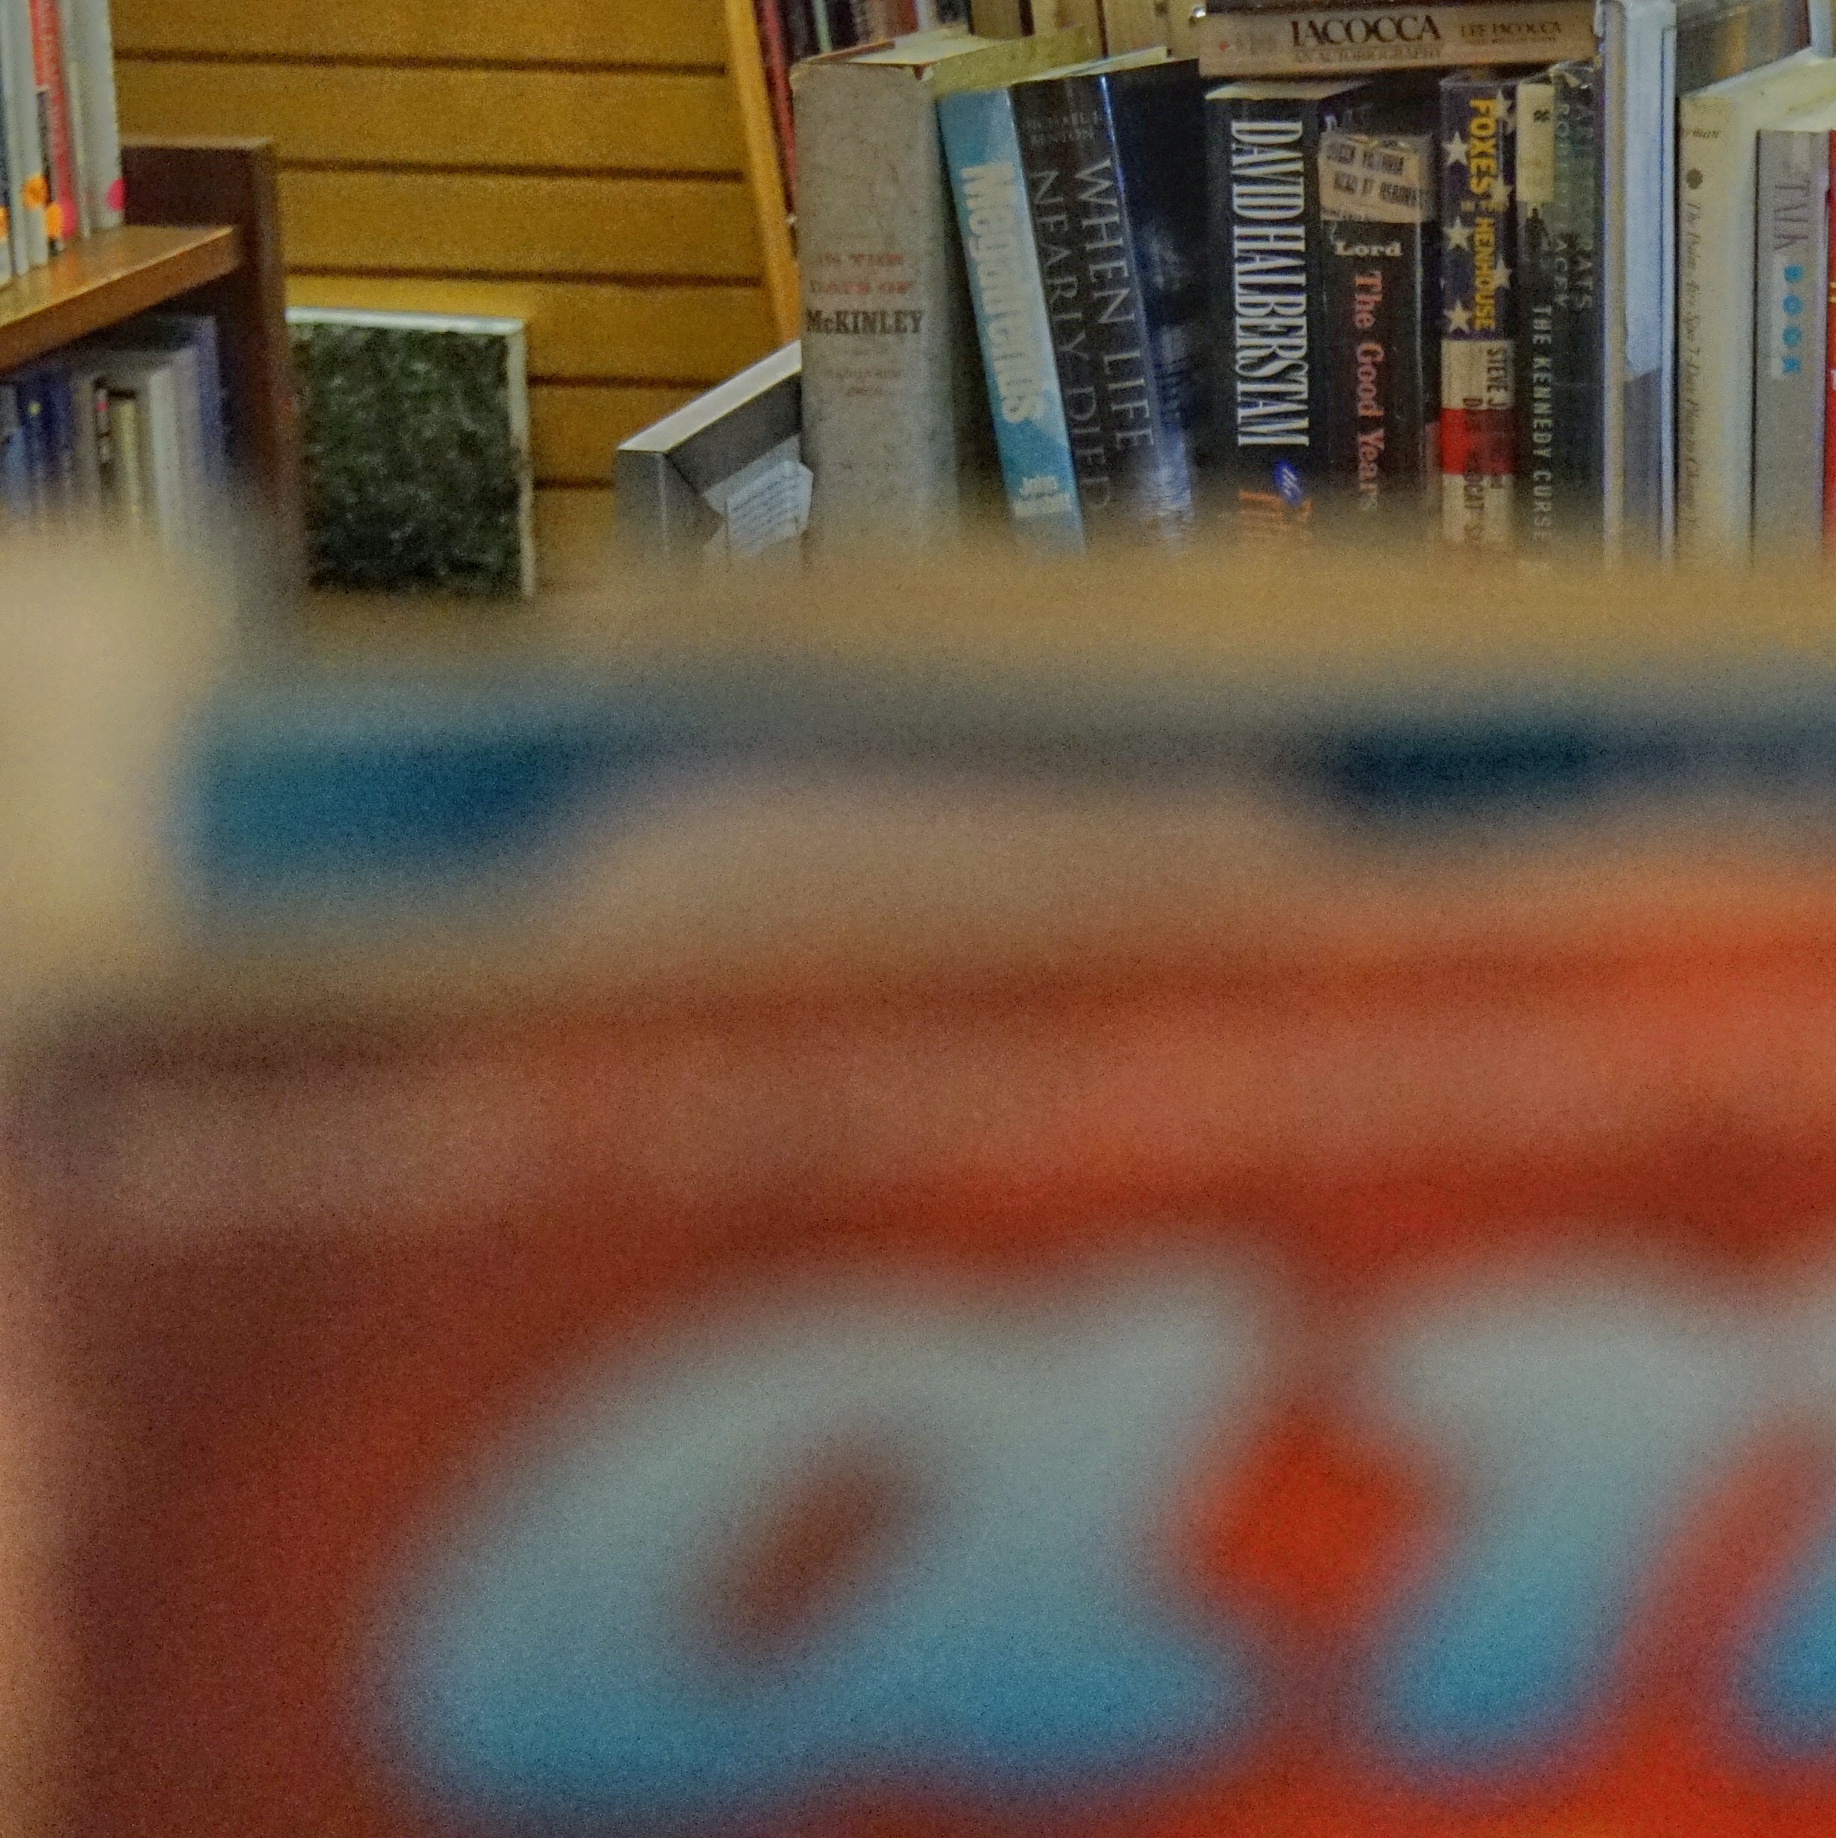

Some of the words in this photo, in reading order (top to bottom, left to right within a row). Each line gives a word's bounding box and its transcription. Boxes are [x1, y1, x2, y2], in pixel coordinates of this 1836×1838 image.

[1292, 14, 1442, 47] IACOCCA
[1231, 121, 1304, 220] DAVID
[1469, 98, 1494, 196] FOXES
[1028, 169, 1091, 360] NEARLY
[1074, 159, 1135, 324] WHEN
[1334, 241, 1403, 257] Lord
[1472, 216, 1495, 331] HENHOUSE
[806, 308, 922, 335] McKINLEY
[1231, 224, 1310, 446] HALBERSTAM
[1354, 270, 1381, 329] The
[1531, 305, 1552, 332] THE
[1103, 349, 1154, 451] LIFE
[1356, 340, 1383, 417] Good
[1532, 356, 1552, 457] KENNEDY
[1532, 470, 1552, 540] CURSE
